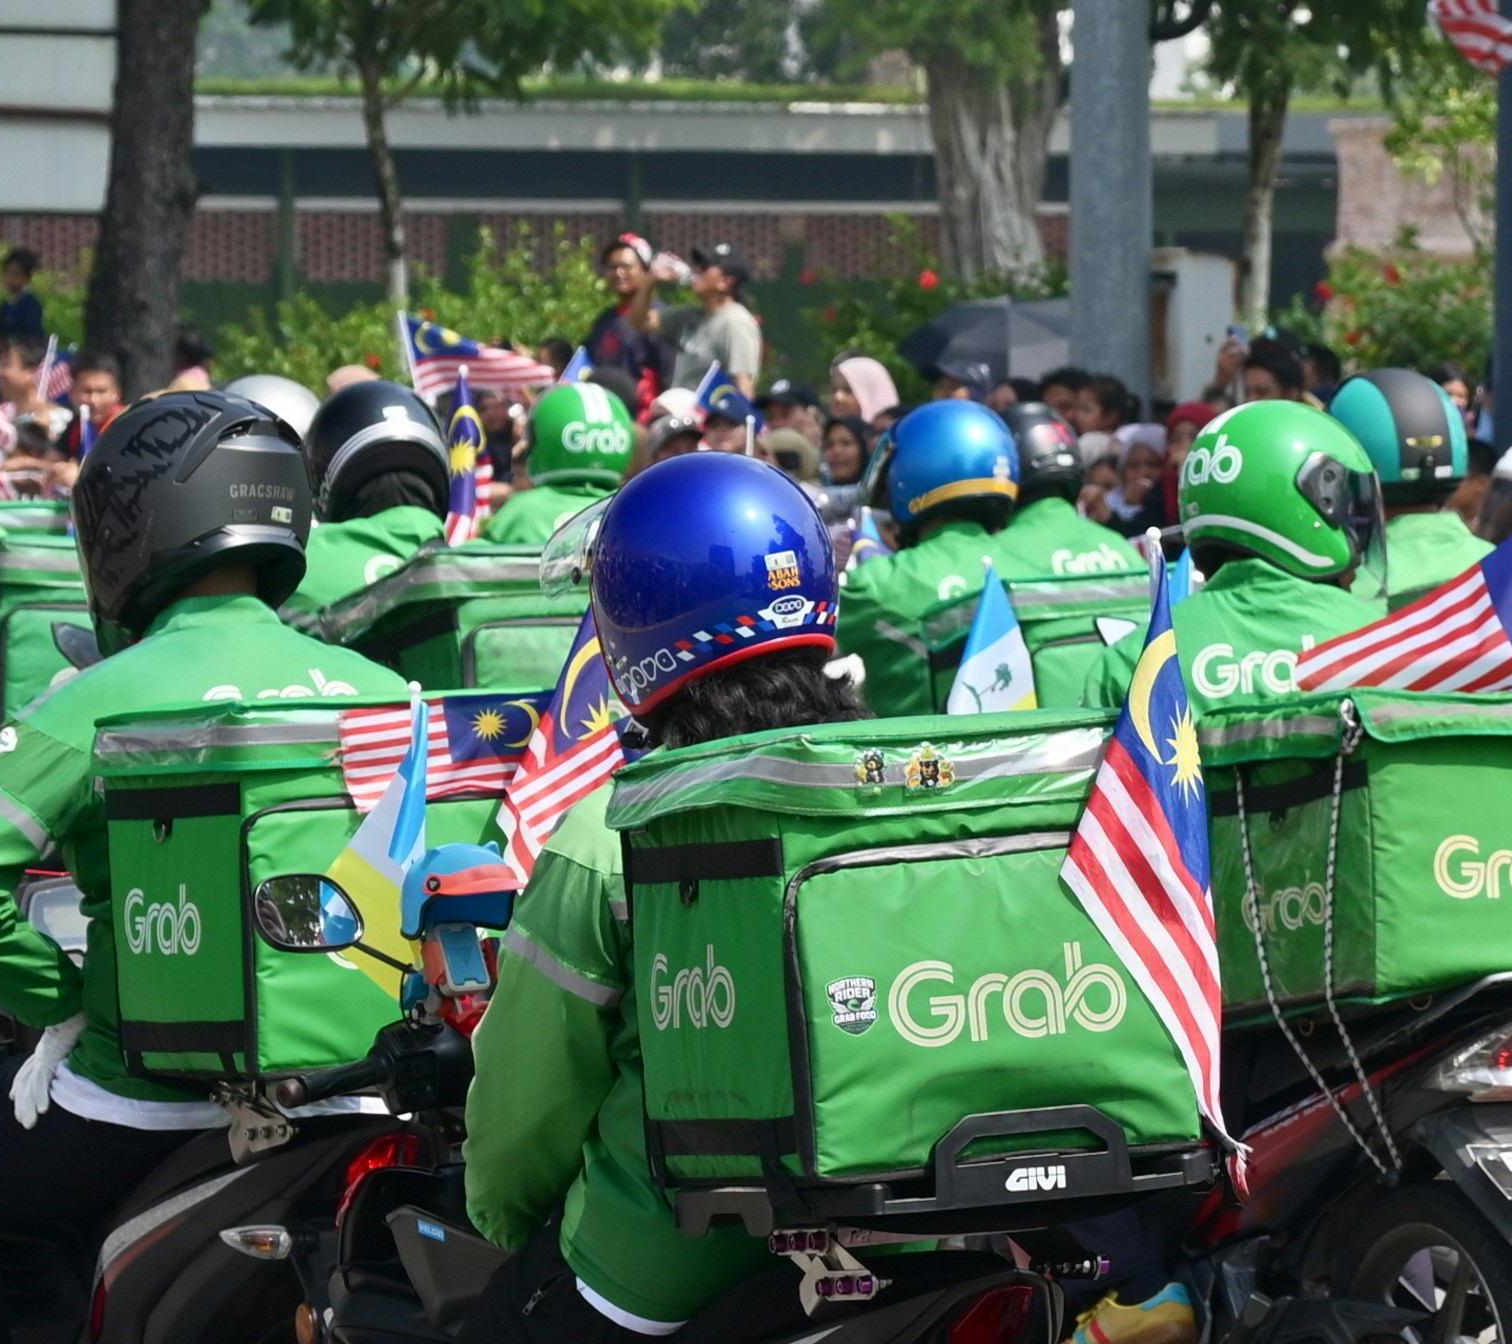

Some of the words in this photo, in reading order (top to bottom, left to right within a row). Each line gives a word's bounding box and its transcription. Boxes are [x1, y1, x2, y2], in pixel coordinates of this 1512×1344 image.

[561, 422, 630, 456] Grab
[1178, 433, 1243, 489] rab
[768, 569, 799, 581] ABAH
[1192, 635, 1317, 699] Gra
[125, 884, 202, 956] Grab
[1241, 868, 1330, 935] Grab
[649, 944, 736, 1032] Grab
[828, 977, 874, 995] NORTHERN
[834, 987, 871, 1003] RIDER
[888, 942, 1127, 1048] Grab
[834, 1014, 856, 1024] GRAB
[1004, 1165, 1067, 1192] GIVI
